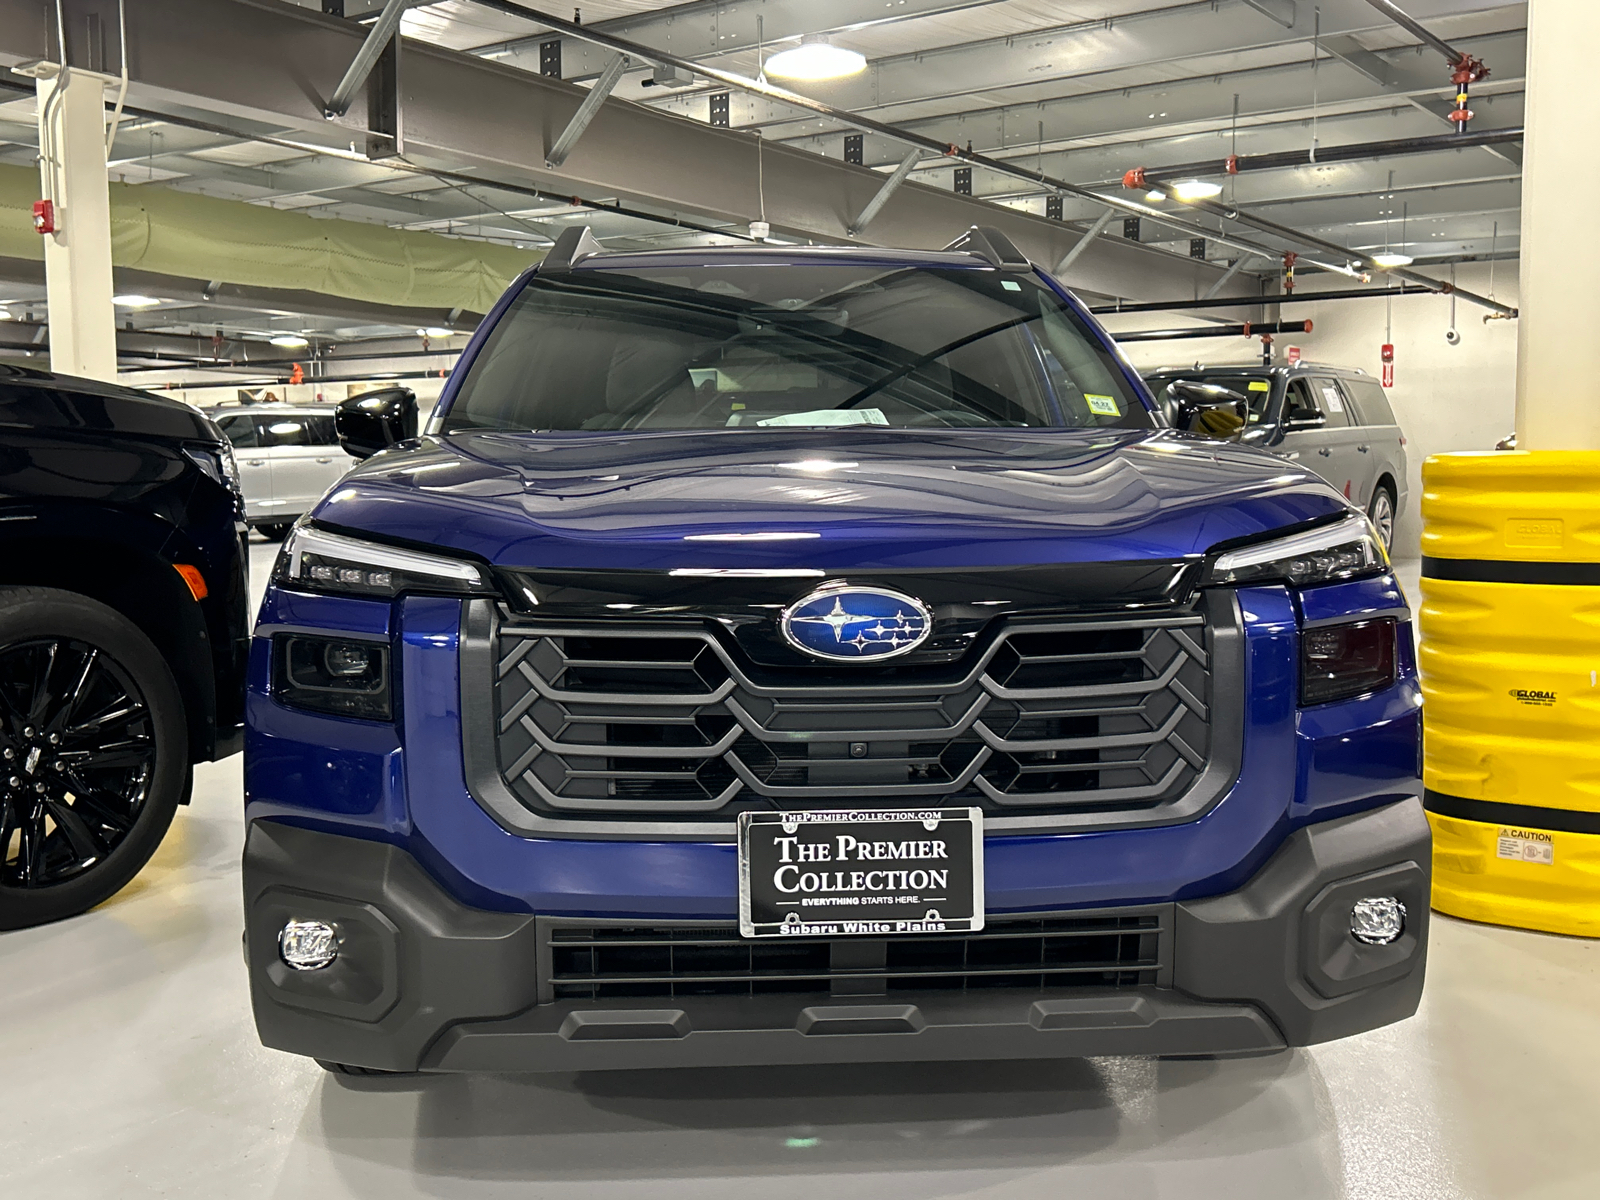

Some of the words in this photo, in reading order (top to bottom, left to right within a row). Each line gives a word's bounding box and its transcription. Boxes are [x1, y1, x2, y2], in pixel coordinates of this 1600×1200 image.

[1516, 689, 1556, 699] GLOBAL
[1511, 829, 1552, 842] CAUTION
[774, 836, 831, 862] THE
[836, 834, 948, 861] PREMIER
[773, 864, 949, 893] COLLECTION
[802, 897, 860, 906] EVERYTHING
[861, 896, 893, 905] STARTS
[895, 895, 921, 904] HERE.
[780, 924, 838, 935] Subaru
[843, 922, 890, 933] White
[896, 921, 946, 932] Plains
